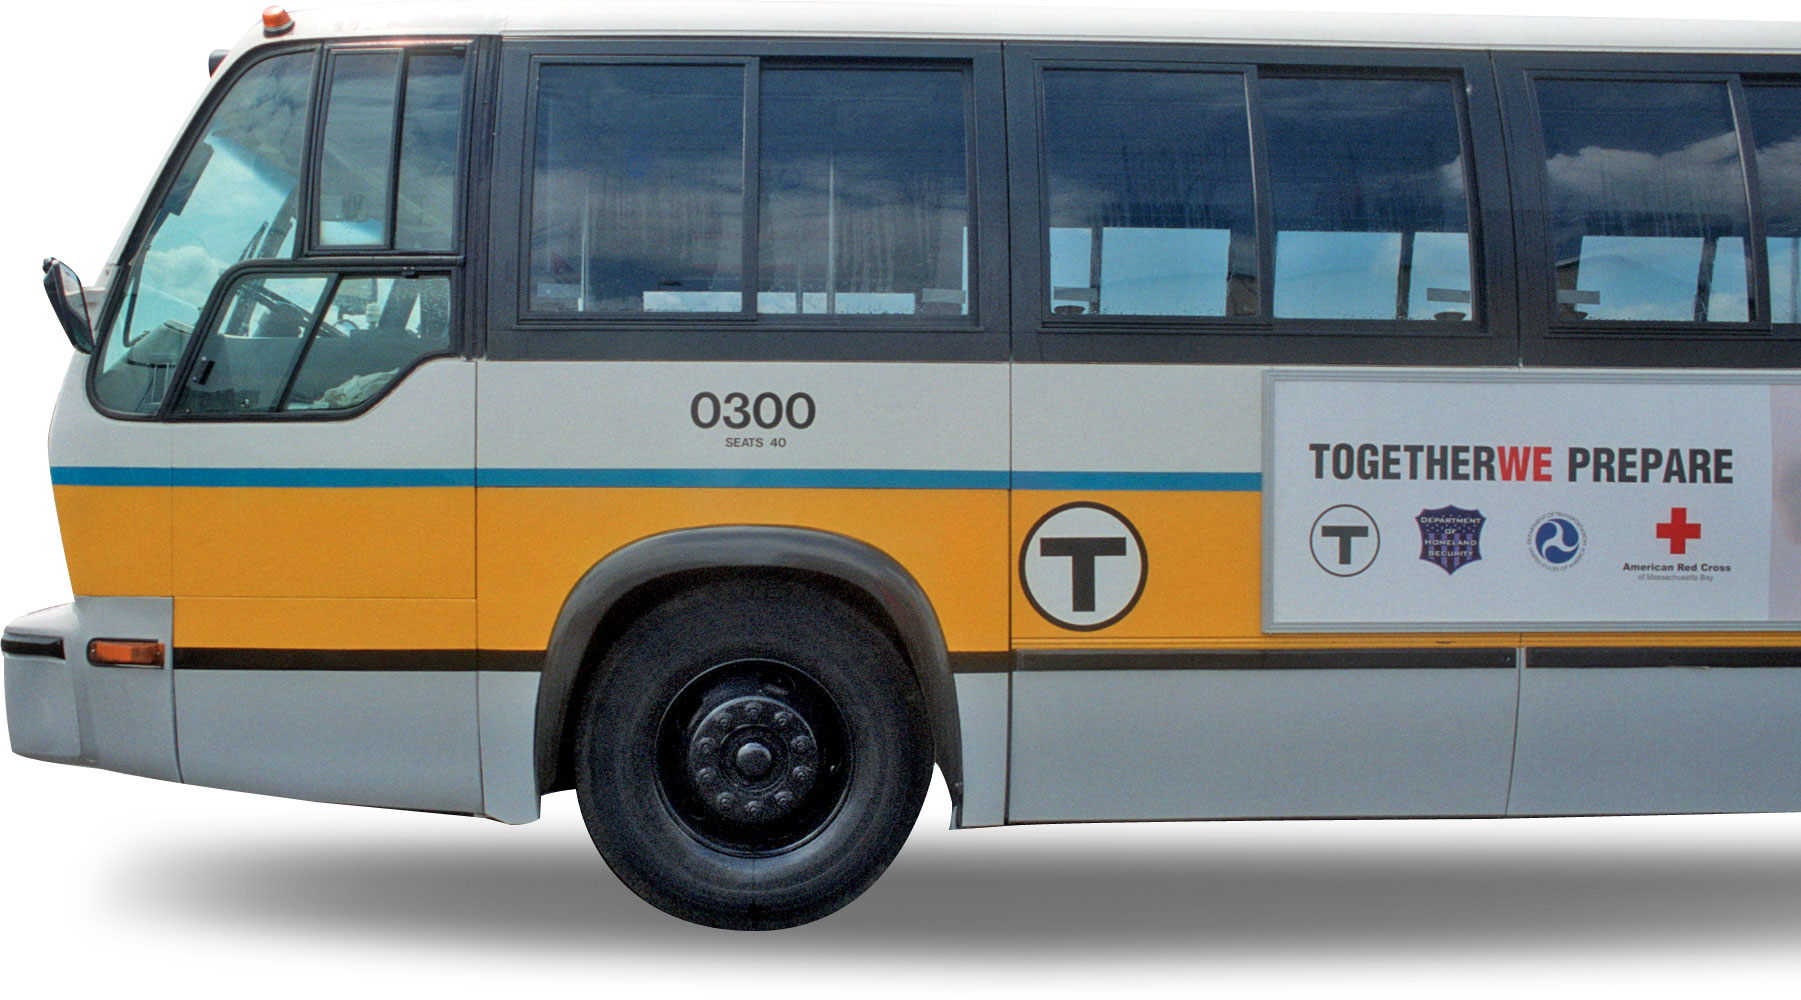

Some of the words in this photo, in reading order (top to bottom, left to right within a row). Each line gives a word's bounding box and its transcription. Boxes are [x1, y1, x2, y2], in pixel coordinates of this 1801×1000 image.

[690, 391, 816, 430] 0300
[725, 437, 764, 448] SEATS
[770, 437, 787, 448] 40
[1568, 447, 1734, 484] PREPARE
[1420, 516, 1481, 524] DEPARTMENT
[1321, 525, 1369, 565] T
[1040, 537, 1127, 612] T
[1623, 563, 1674, 571] American
[1699, 574, 1714, 582] Bay
